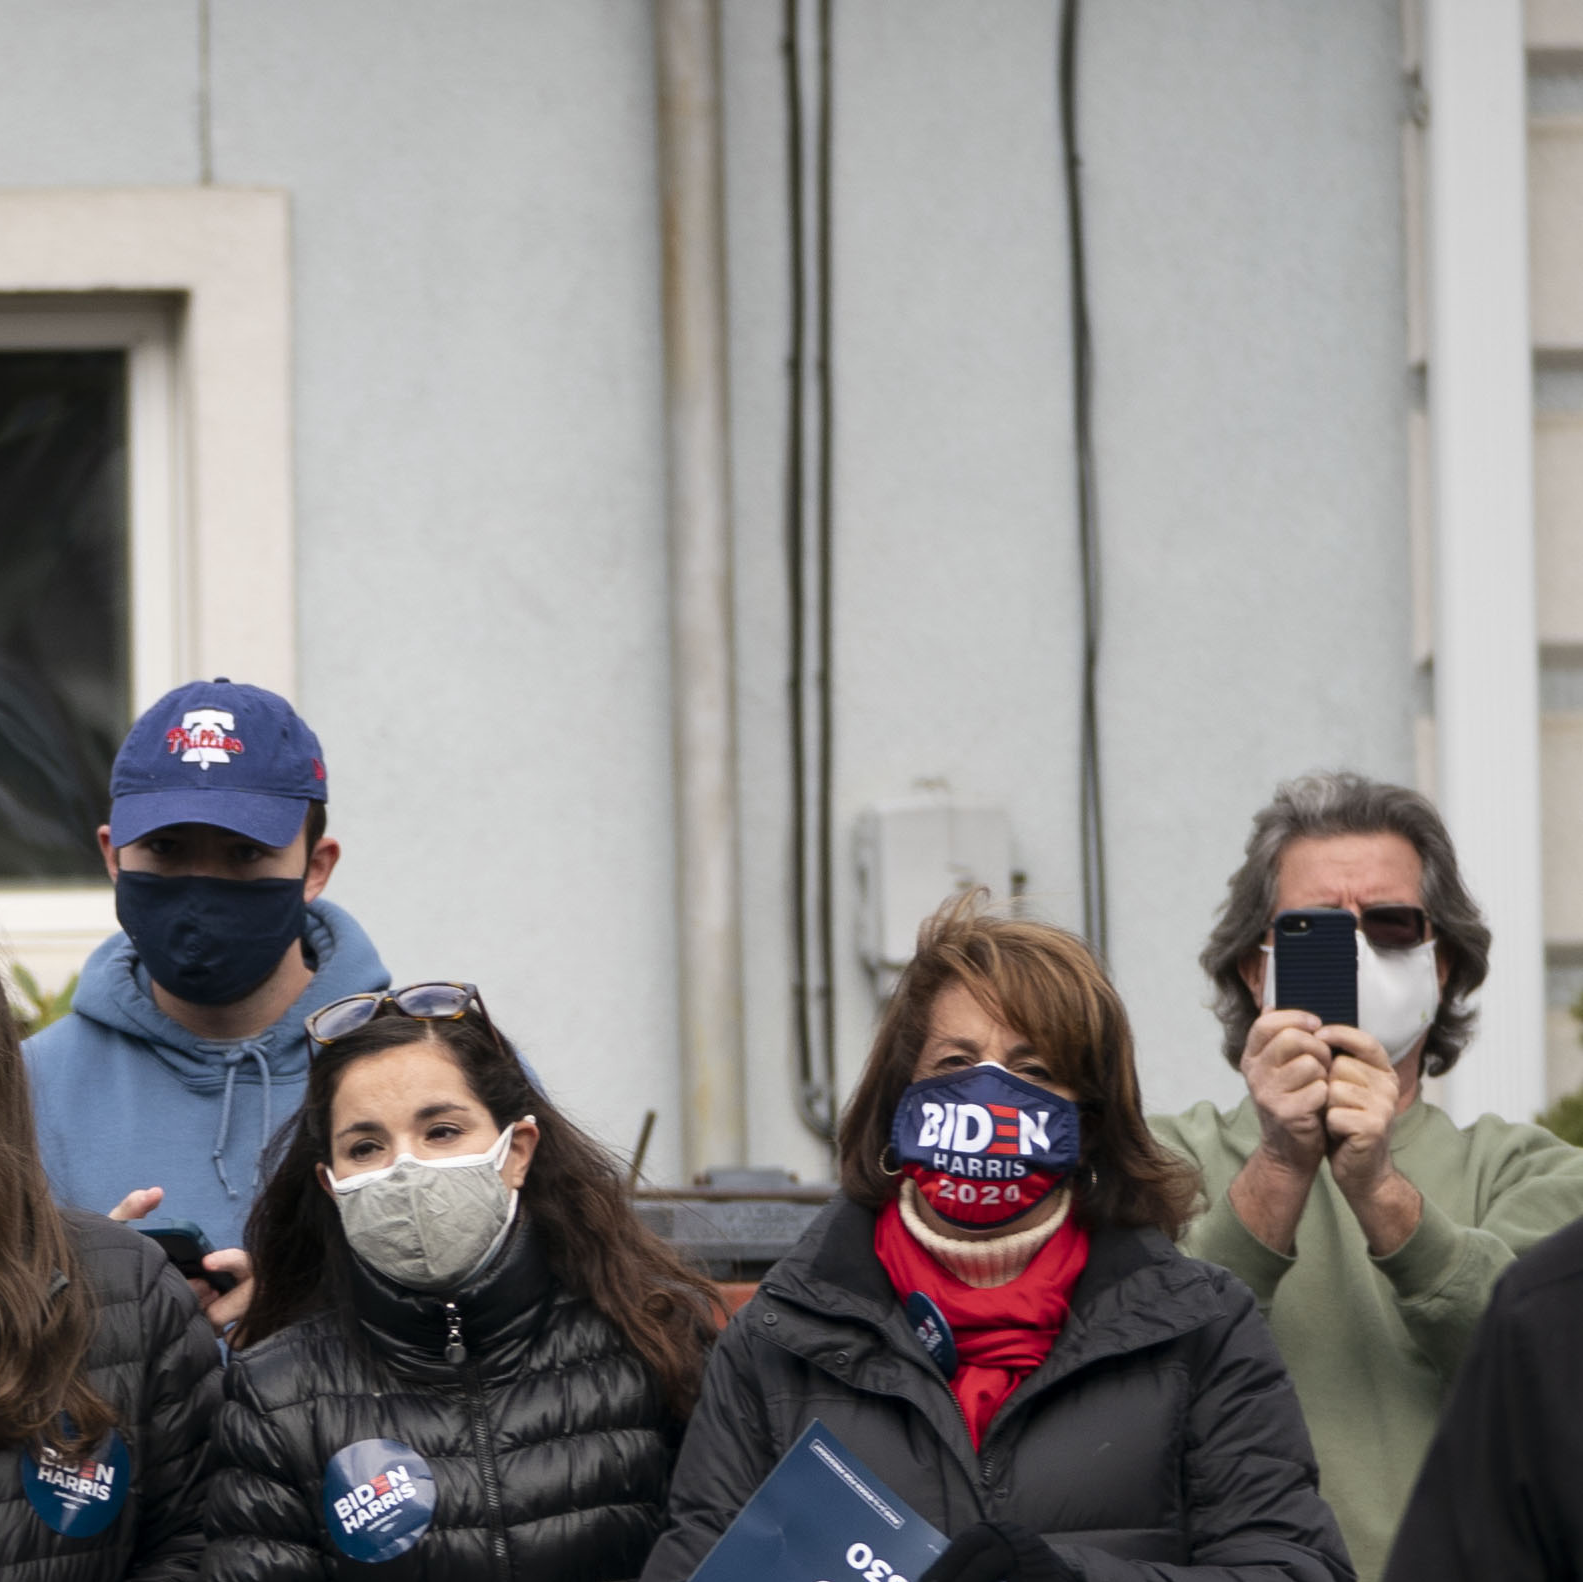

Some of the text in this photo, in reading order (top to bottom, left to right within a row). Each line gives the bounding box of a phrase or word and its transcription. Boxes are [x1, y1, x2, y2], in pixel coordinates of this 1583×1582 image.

[917, 1102, 1051, 1155] BIDEN
[933, 1152, 1027, 1178] HARRIS
[938, 1179, 1021, 1204] 2020
[38, 1466, 111, 1501] HARRIS
[334, 1465, 410, 1519] BIDEN
[342, 1482, 416, 1534] HARRIS
